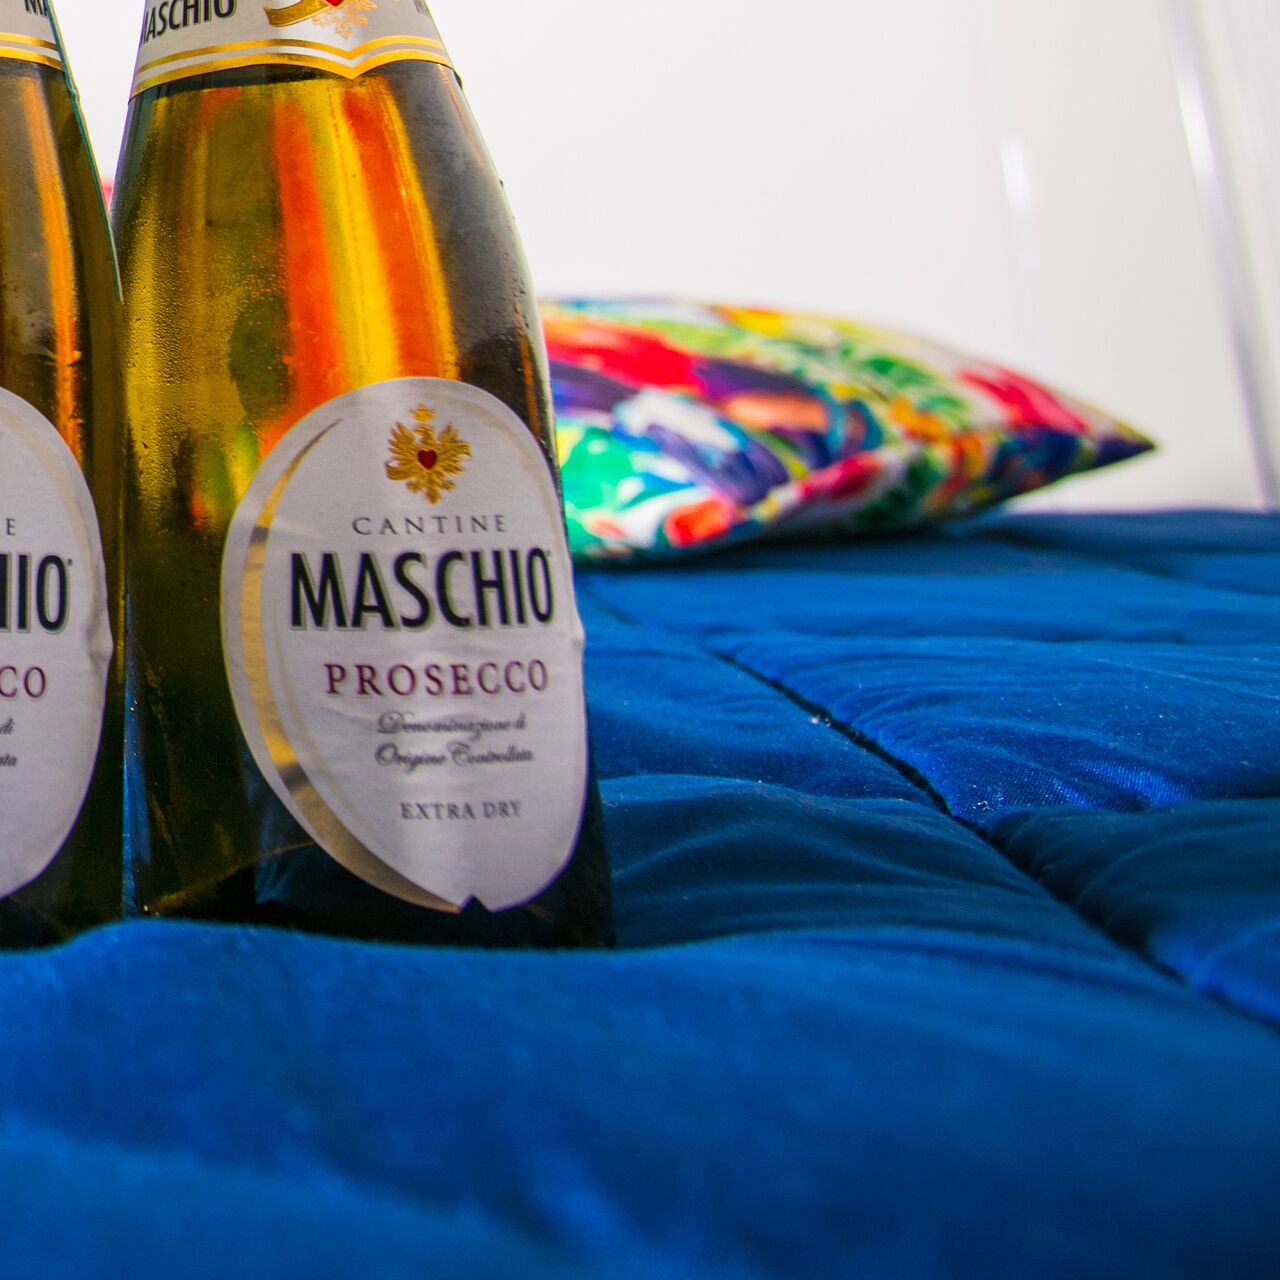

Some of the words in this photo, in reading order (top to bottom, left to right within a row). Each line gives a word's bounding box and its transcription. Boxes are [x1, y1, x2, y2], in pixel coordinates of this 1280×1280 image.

[352, 514, 506, 536] CANTINE
[288, 547, 555, 632] MASCHIO
[324, 659, 550, 697] PROSECCO
[400, 801, 476, 820] EXTRA
[482, 799, 521, 818] DRY
